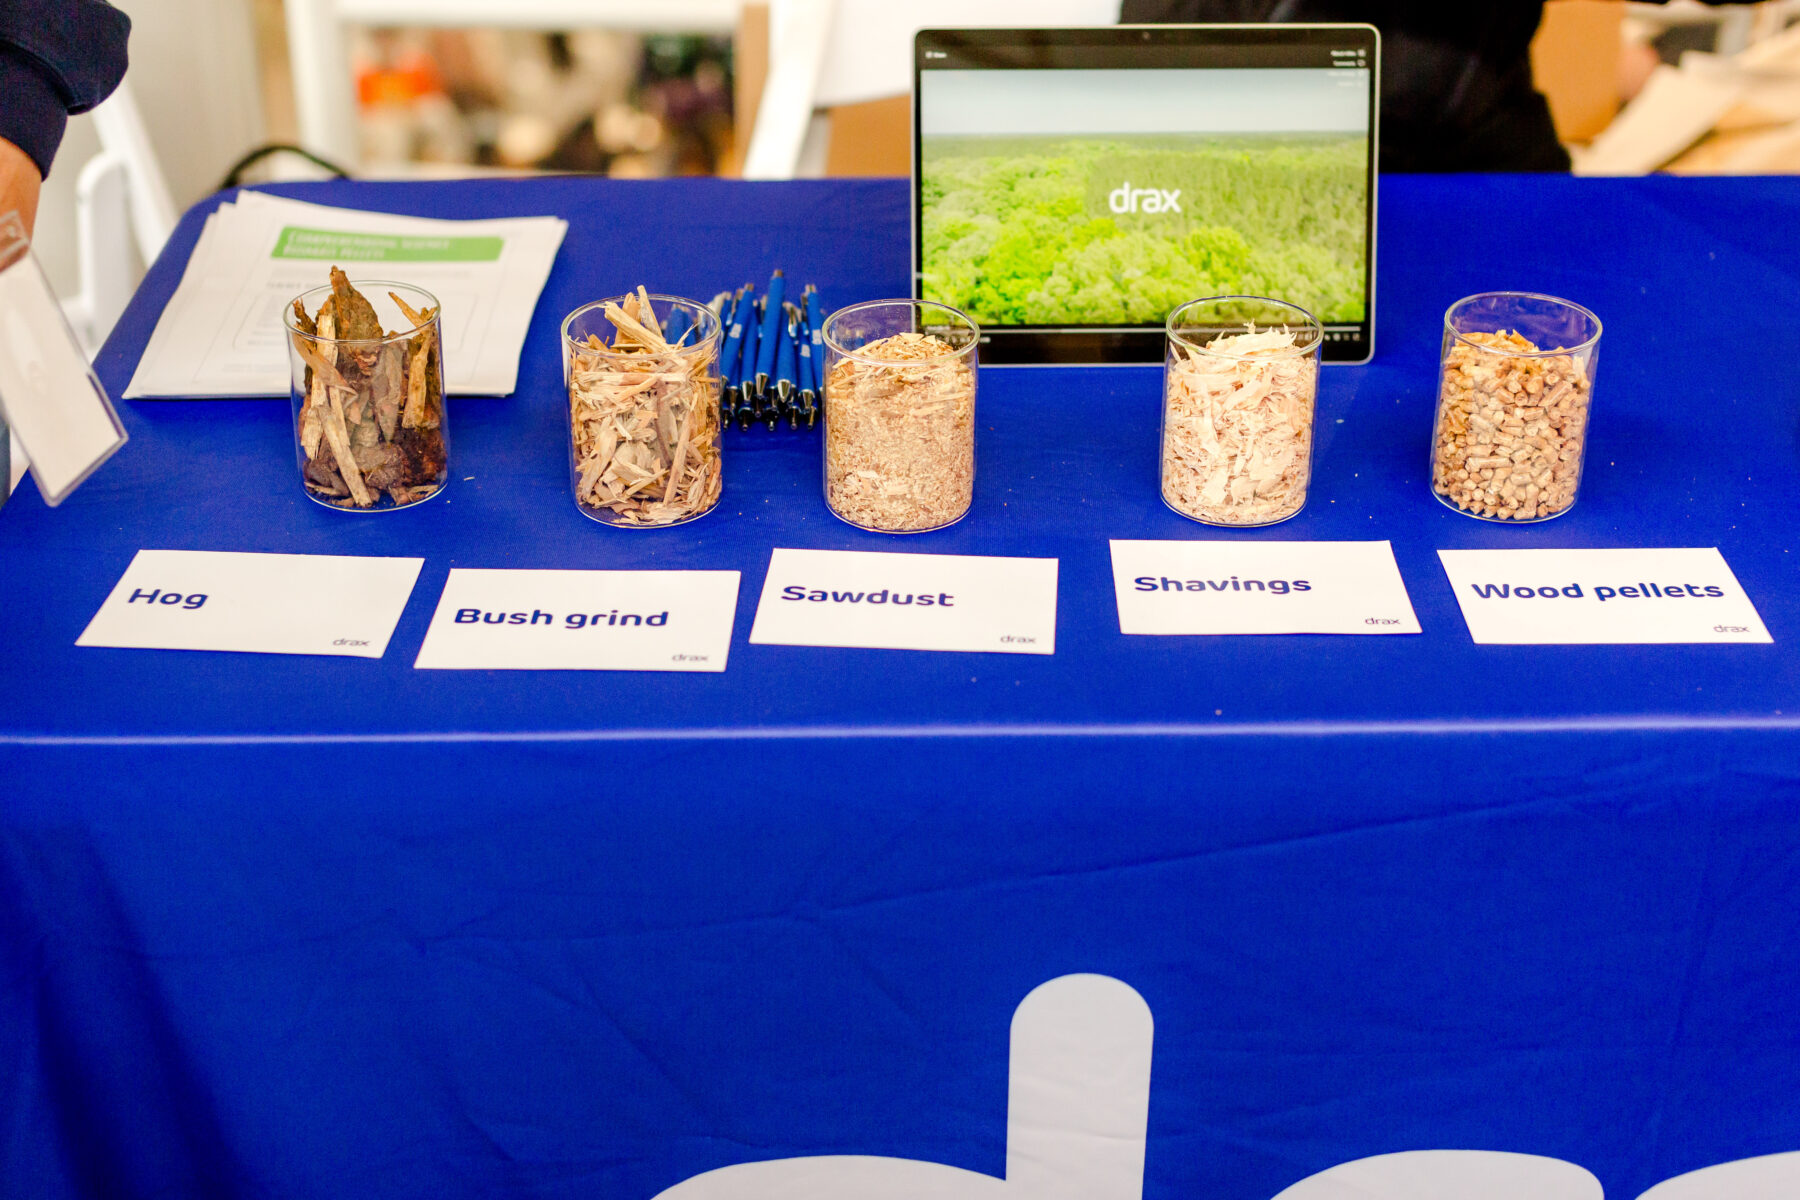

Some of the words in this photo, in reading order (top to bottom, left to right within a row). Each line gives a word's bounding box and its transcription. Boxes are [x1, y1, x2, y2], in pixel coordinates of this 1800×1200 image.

[1109, 182, 1182, 214] drax
[1134, 576, 1312, 595] Shavings
[1471, 583, 1584, 598] Wood
[1594, 583, 1725, 602] pellets
[128, 588, 208, 609] Hog
[781, 586, 954, 607] Sawdust
[454, 608, 553, 625] Bush
[565, 610, 669, 629] grind
[1365, 617, 1401, 626] drax
[1714, 624, 1751, 634] drax
[332, 638, 371, 648] drax
[1000, 635, 1036, 645] drax
[672, 654, 710, 663] drax
